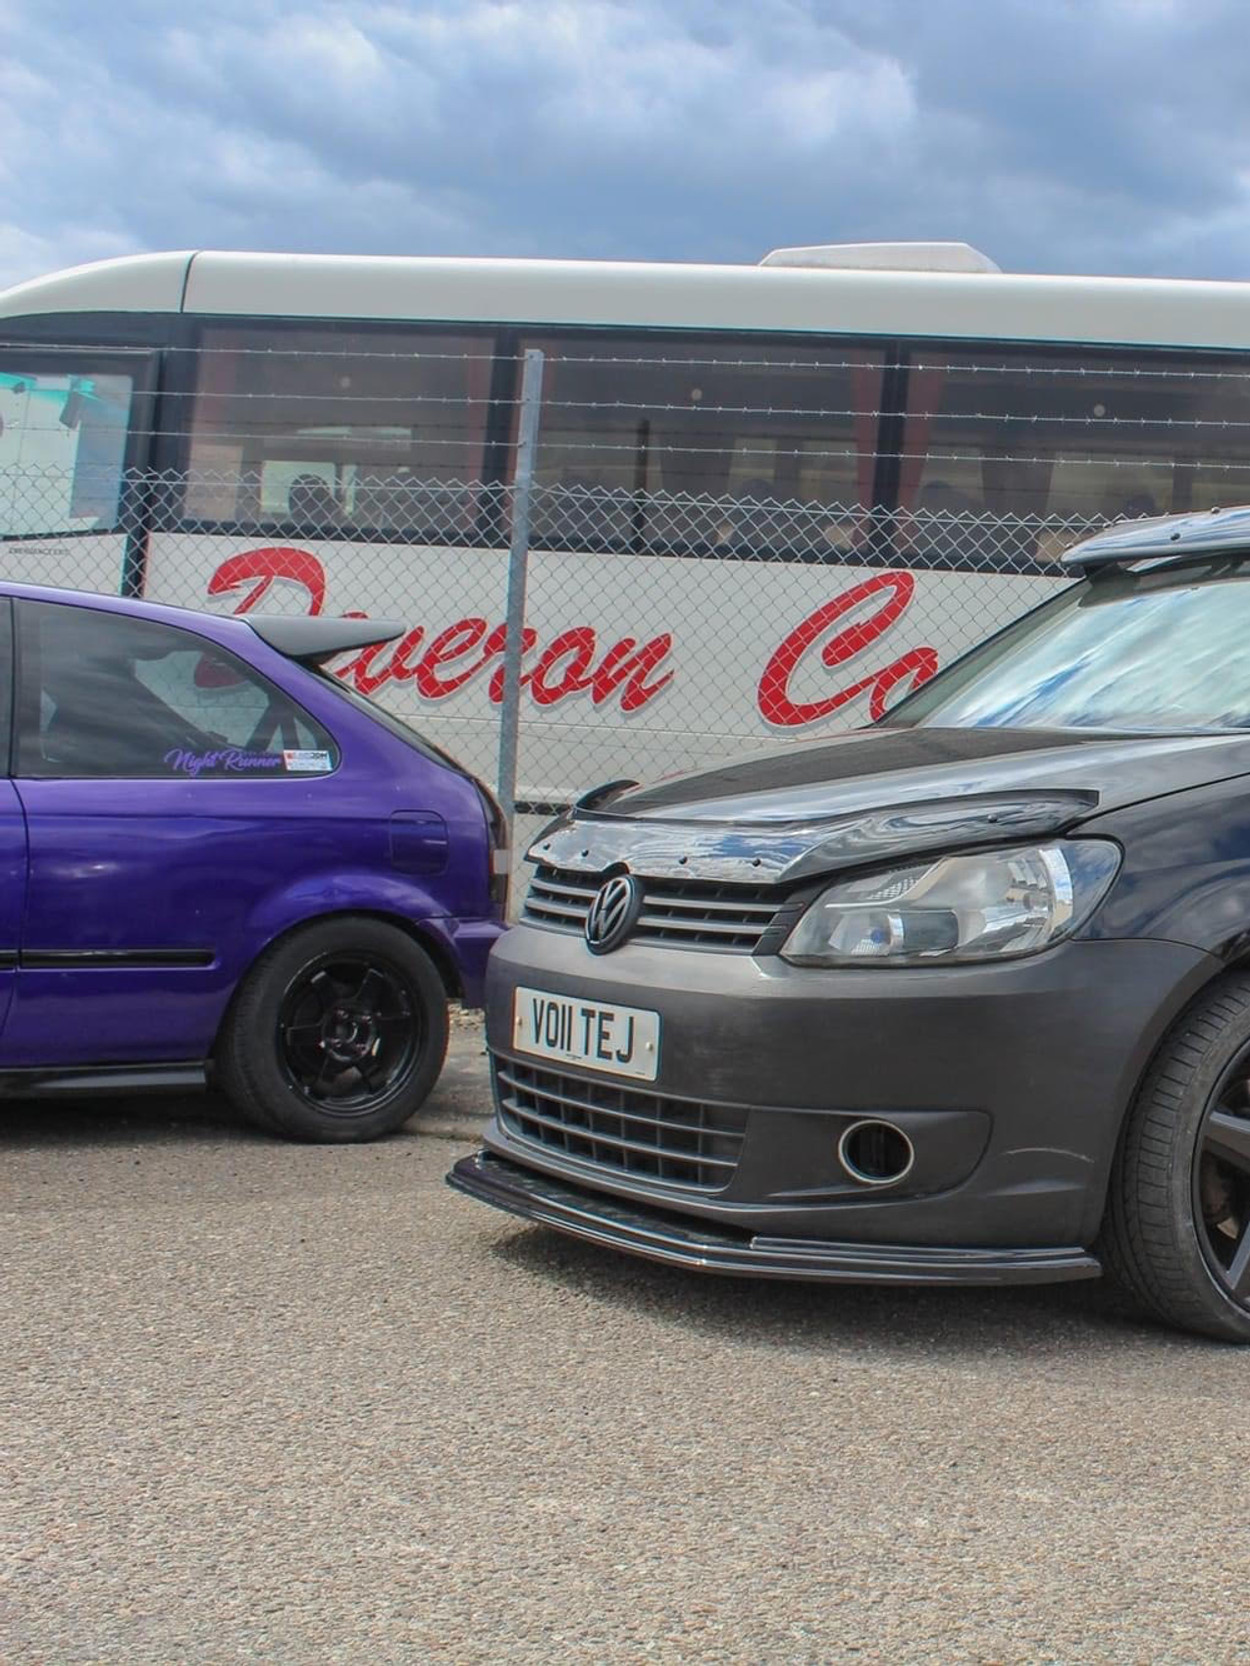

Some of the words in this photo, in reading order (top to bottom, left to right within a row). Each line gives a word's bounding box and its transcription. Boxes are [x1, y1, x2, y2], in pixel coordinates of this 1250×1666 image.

[207, 546, 675, 711] Dveron
[163, 748, 218, 776] Night
[219, 749, 282, 771] Runner
[580, 1008, 635, 1063] TEJ
